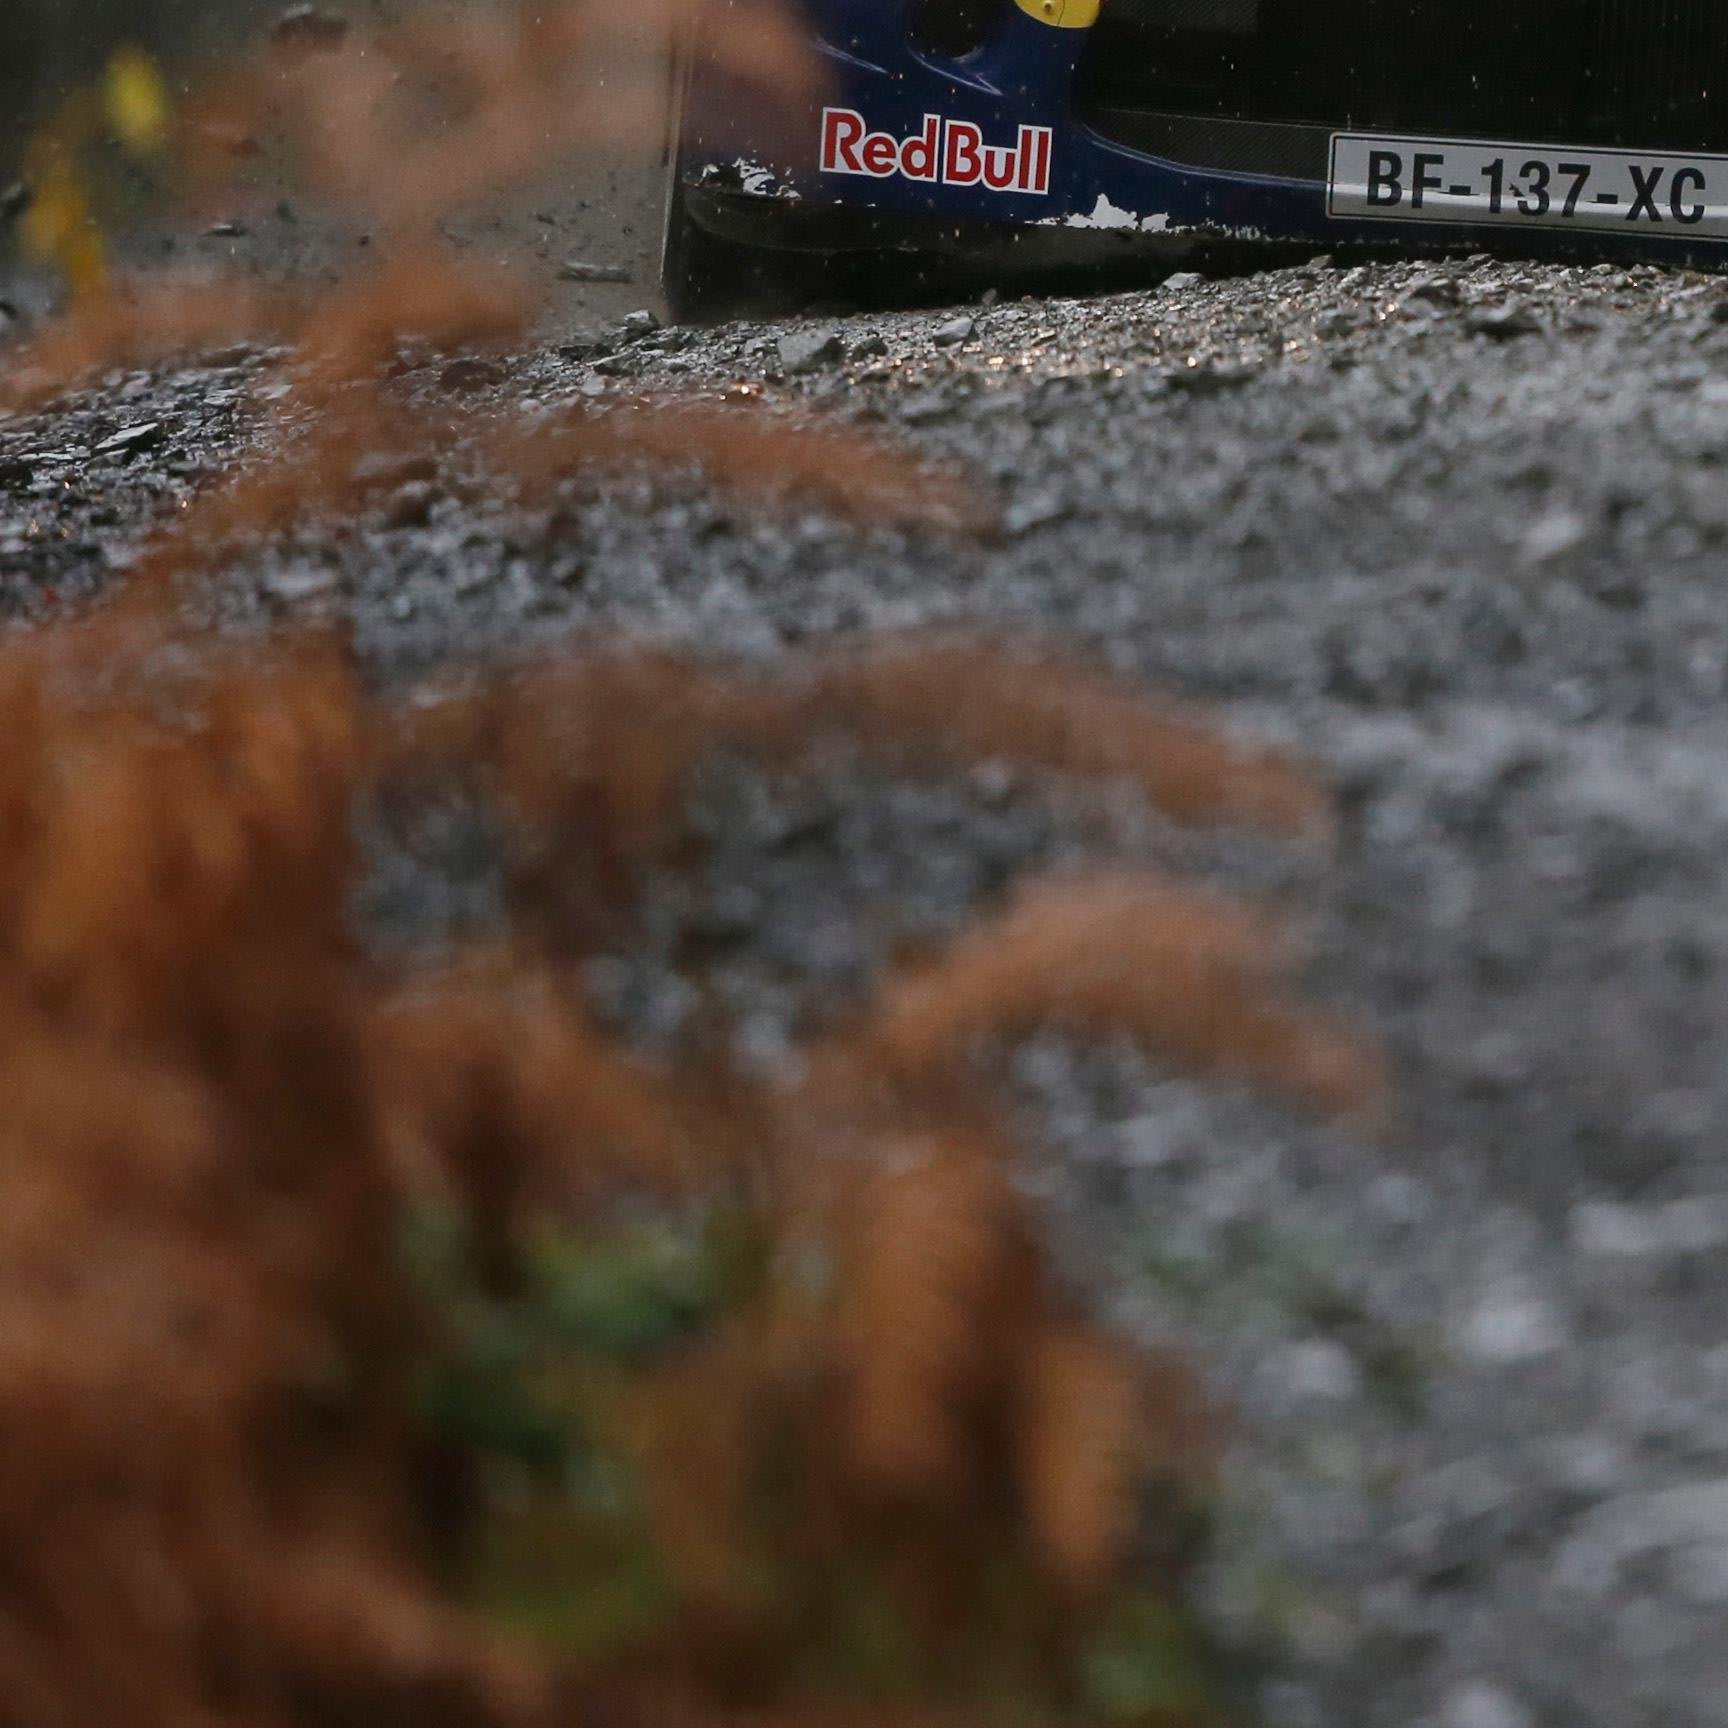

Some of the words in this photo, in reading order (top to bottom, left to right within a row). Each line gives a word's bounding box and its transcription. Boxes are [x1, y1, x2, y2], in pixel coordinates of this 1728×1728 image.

[820, 107, 941, 182] Red
[943, 119, 1053, 195] Bull
[1367, 150, 1707, 225] BF-137-XC
